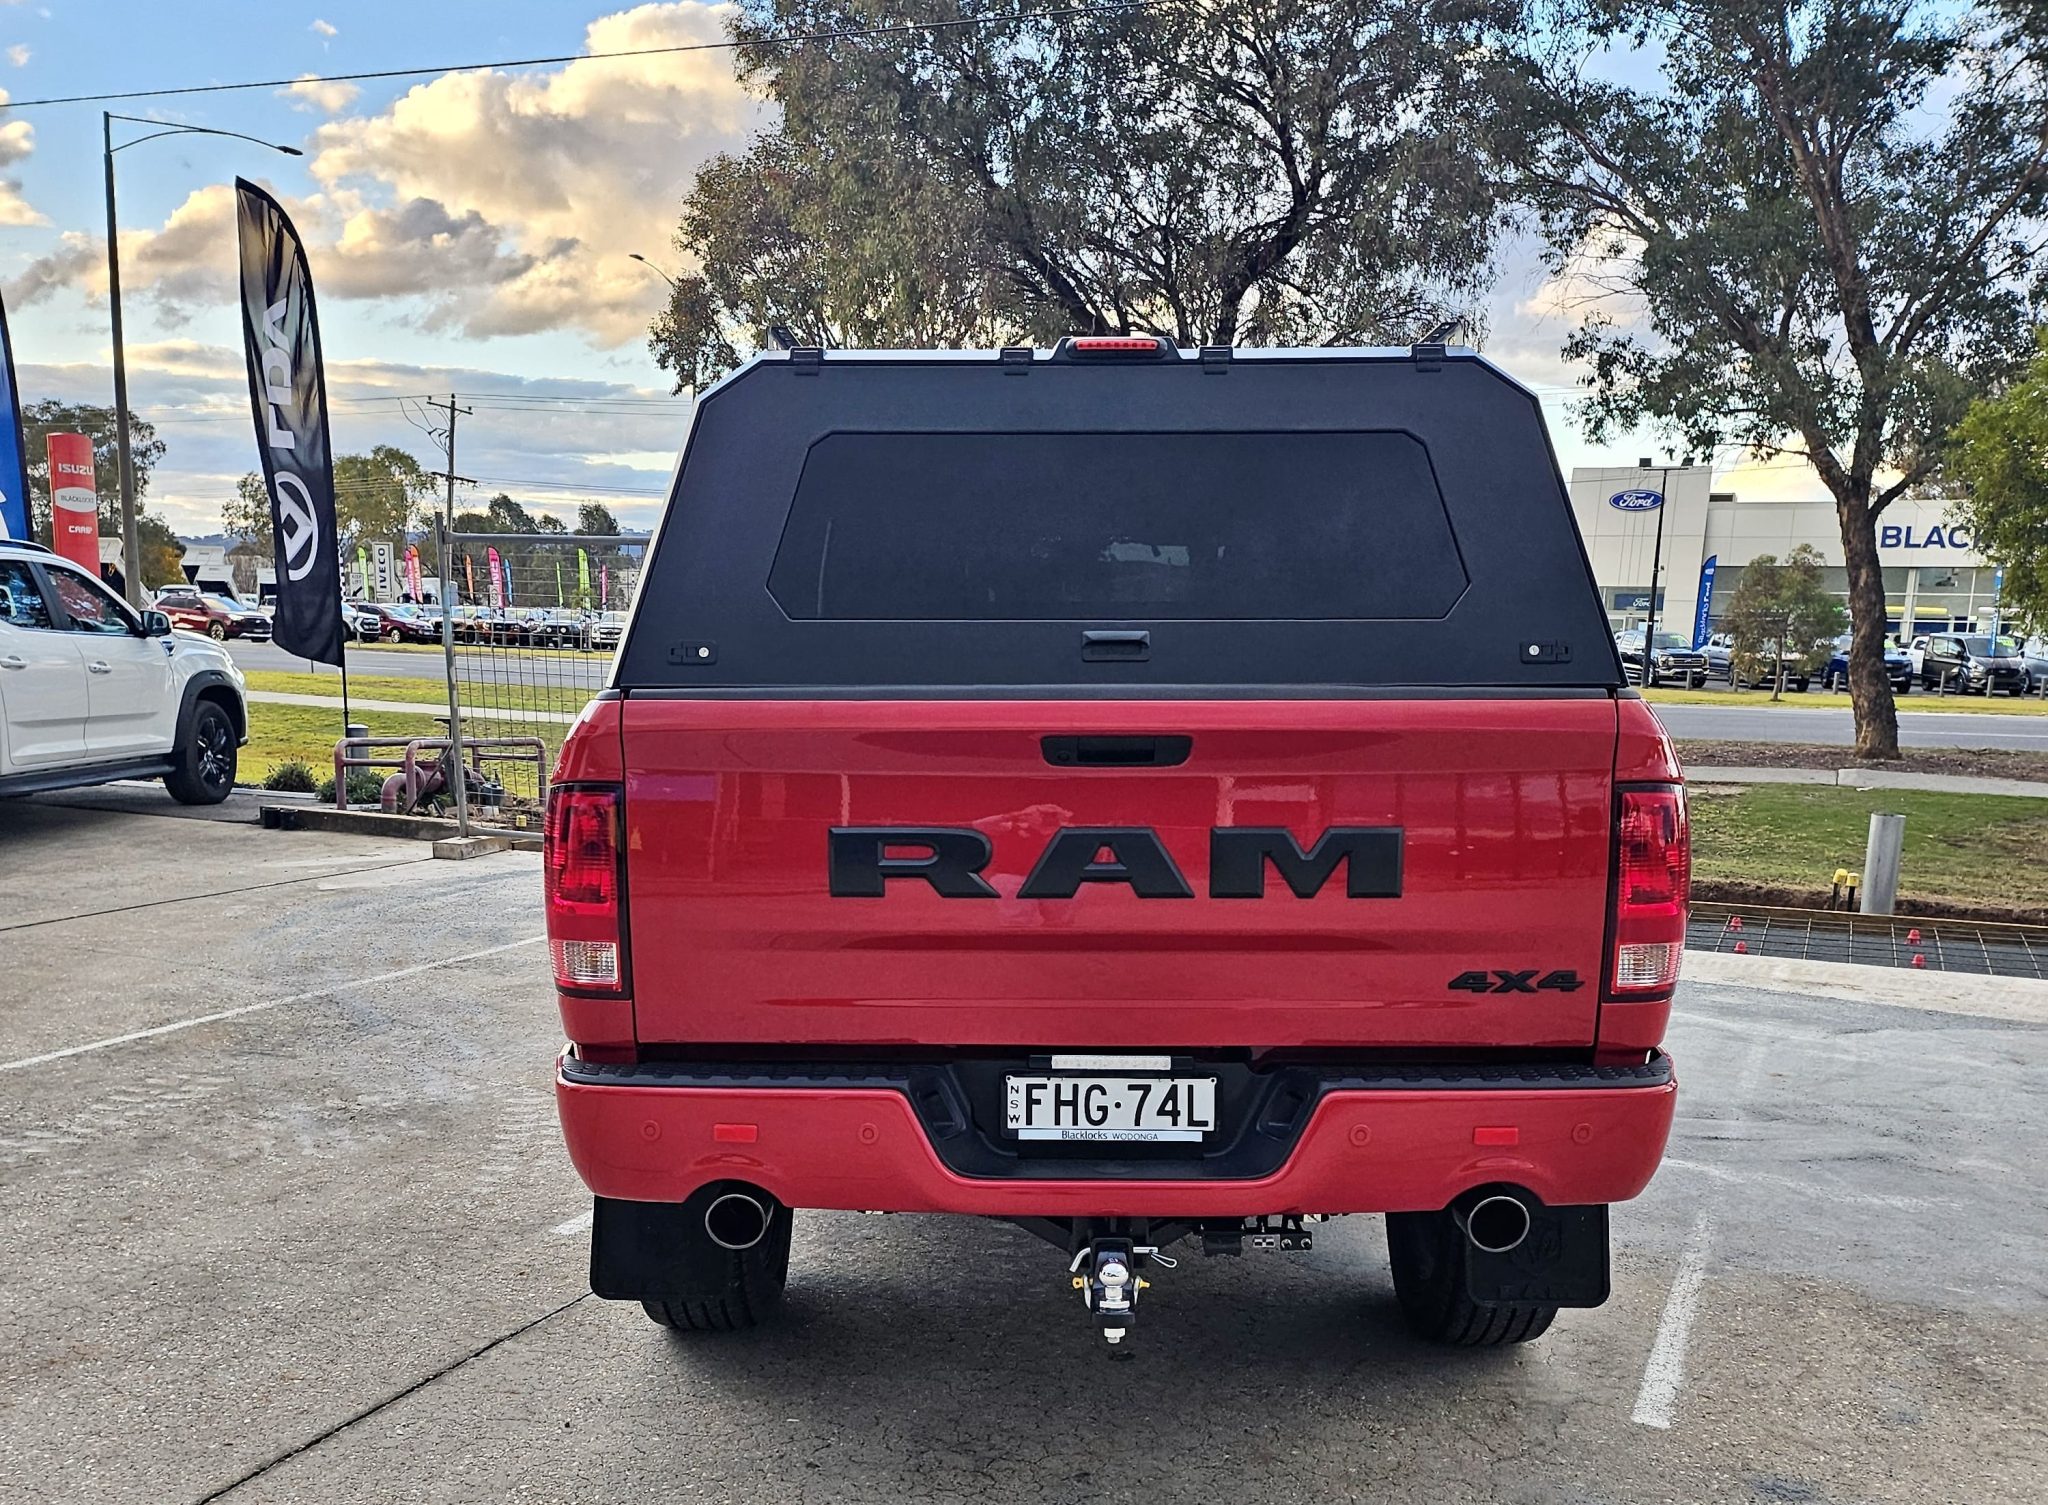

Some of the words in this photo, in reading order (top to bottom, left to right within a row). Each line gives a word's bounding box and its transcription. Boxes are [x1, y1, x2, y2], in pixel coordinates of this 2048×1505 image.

[58, 463, 93, 475] ISUZU
[1619, 493, 1655, 507] Ford
[1880, 526, 1980, 549] BLAC
[378, 547, 387, 589] IVECO
[827, 825, 1404, 898] RAM
[1061, 1130, 1108, 1140] Blacklocks
[1112, 1132, 1158, 1141] WODONGA
